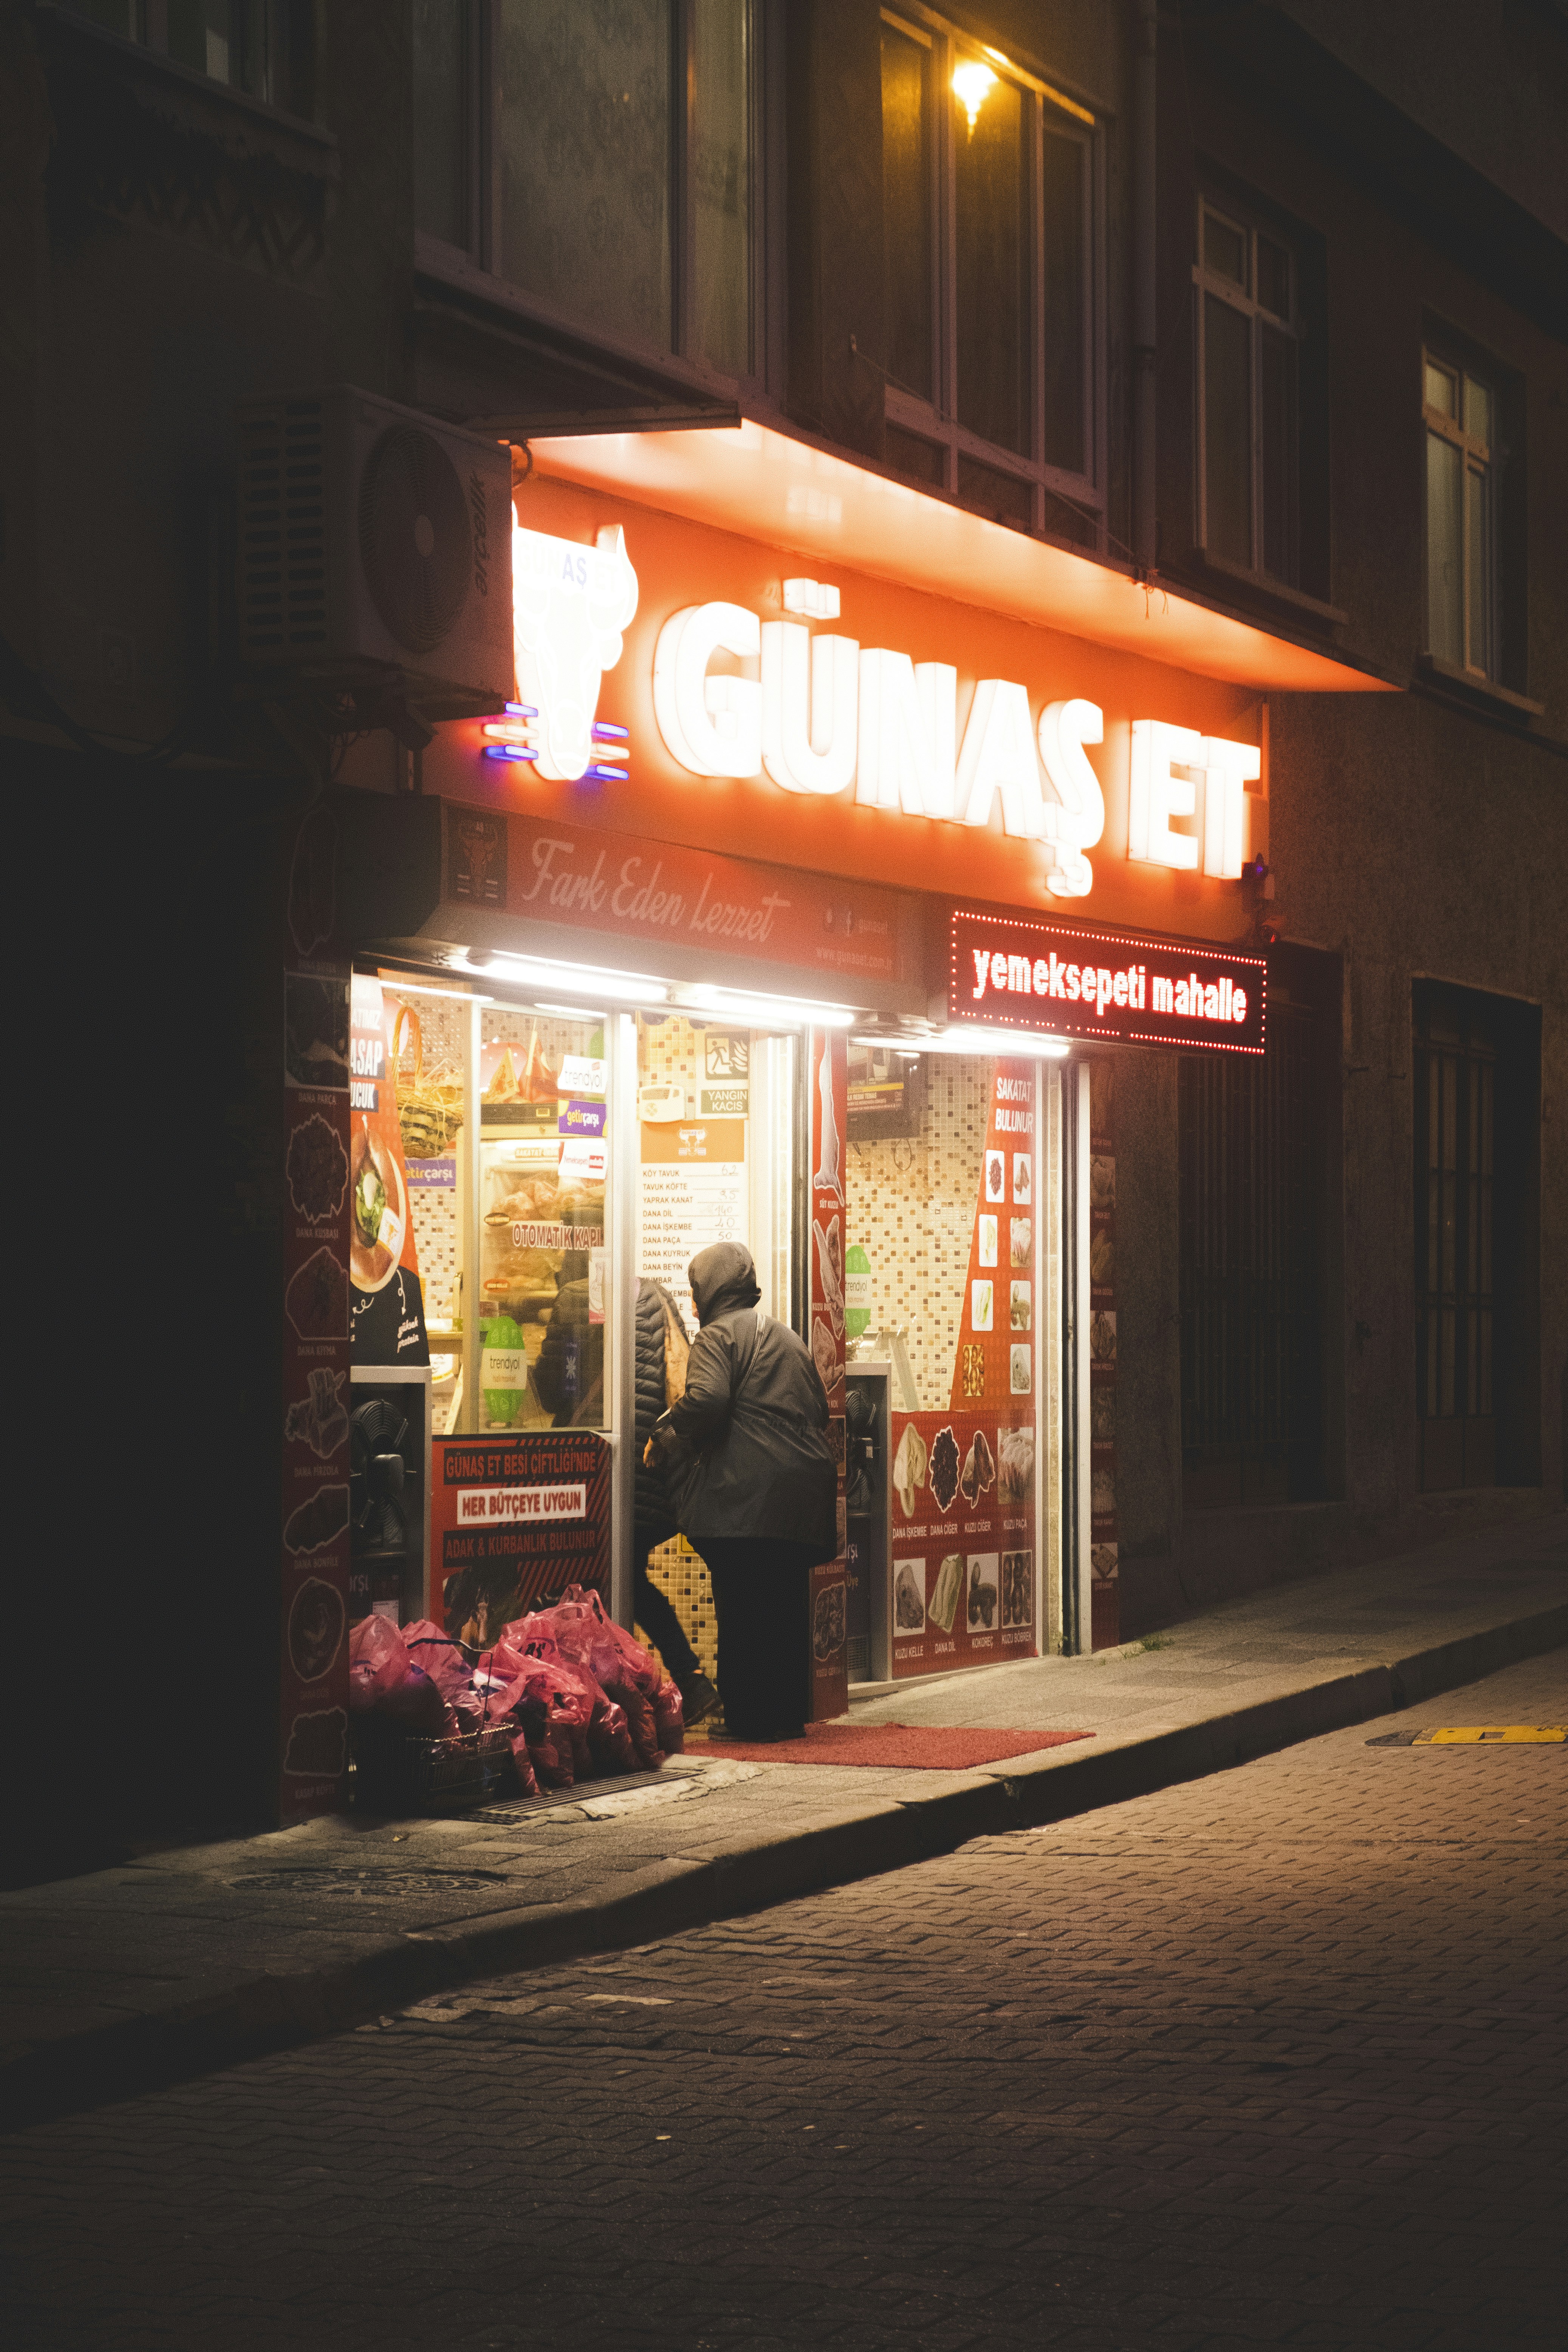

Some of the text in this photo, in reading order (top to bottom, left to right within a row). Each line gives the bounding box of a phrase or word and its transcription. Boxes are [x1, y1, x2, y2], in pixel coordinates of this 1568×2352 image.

[653, 577, 1261, 898] GÜNAŞ ET
[523, 837, 791, 942] Fark Eden Lezzet
[973, 949, 1247, 1022] yemeksepeti mahalle
[351, 1038, 382, 1077] ASAP
[565, 1070, 602, 1090] trendyol
[351, 1082, 375, 1109] UCUK
[708, 1090, 747, 1100] YANGIN
[997, 1077, 1032, 1102] SAKATAT
[995, 1108, 1033, 1133] BULUNUR
[405, 1167, 453, 1182] etirçarşı
[513, 1221, 573, 1250] OTOMATİK
[663, 1222, 692, 1232] İŞKEMBE
[663, 1262, 683, 1270] BEYİN
[845, 1279, 867, 1294] trendyol
[490, 1355, 520, 1371] trendyol
[446, 1452, 484, 1482] GÜNAŞ
[488, 1455, 501, 1475] ET
[504, 1450, 528, 1475] BESİ
[463, 1491, 581, 1519] HER BÜTÇEYE UYGUN
[892, 1524, 927, 1540] DANA İŞKEMBE
[930, 1524, 943, 1536] DANA
[964, 1522, 977, 1533] KUZU
[1003, 1519, 1015, 1530] KUZU
[445, 1538, 474, 1558] ADAK
[489, 1533, 548, 1555] KURBANLIK
[550, 1530, 596, 1552] BULUNUR
[895, 1645, 924, 1659] KUZU KELLE
[935, 1642, 948, 1654] DANA
